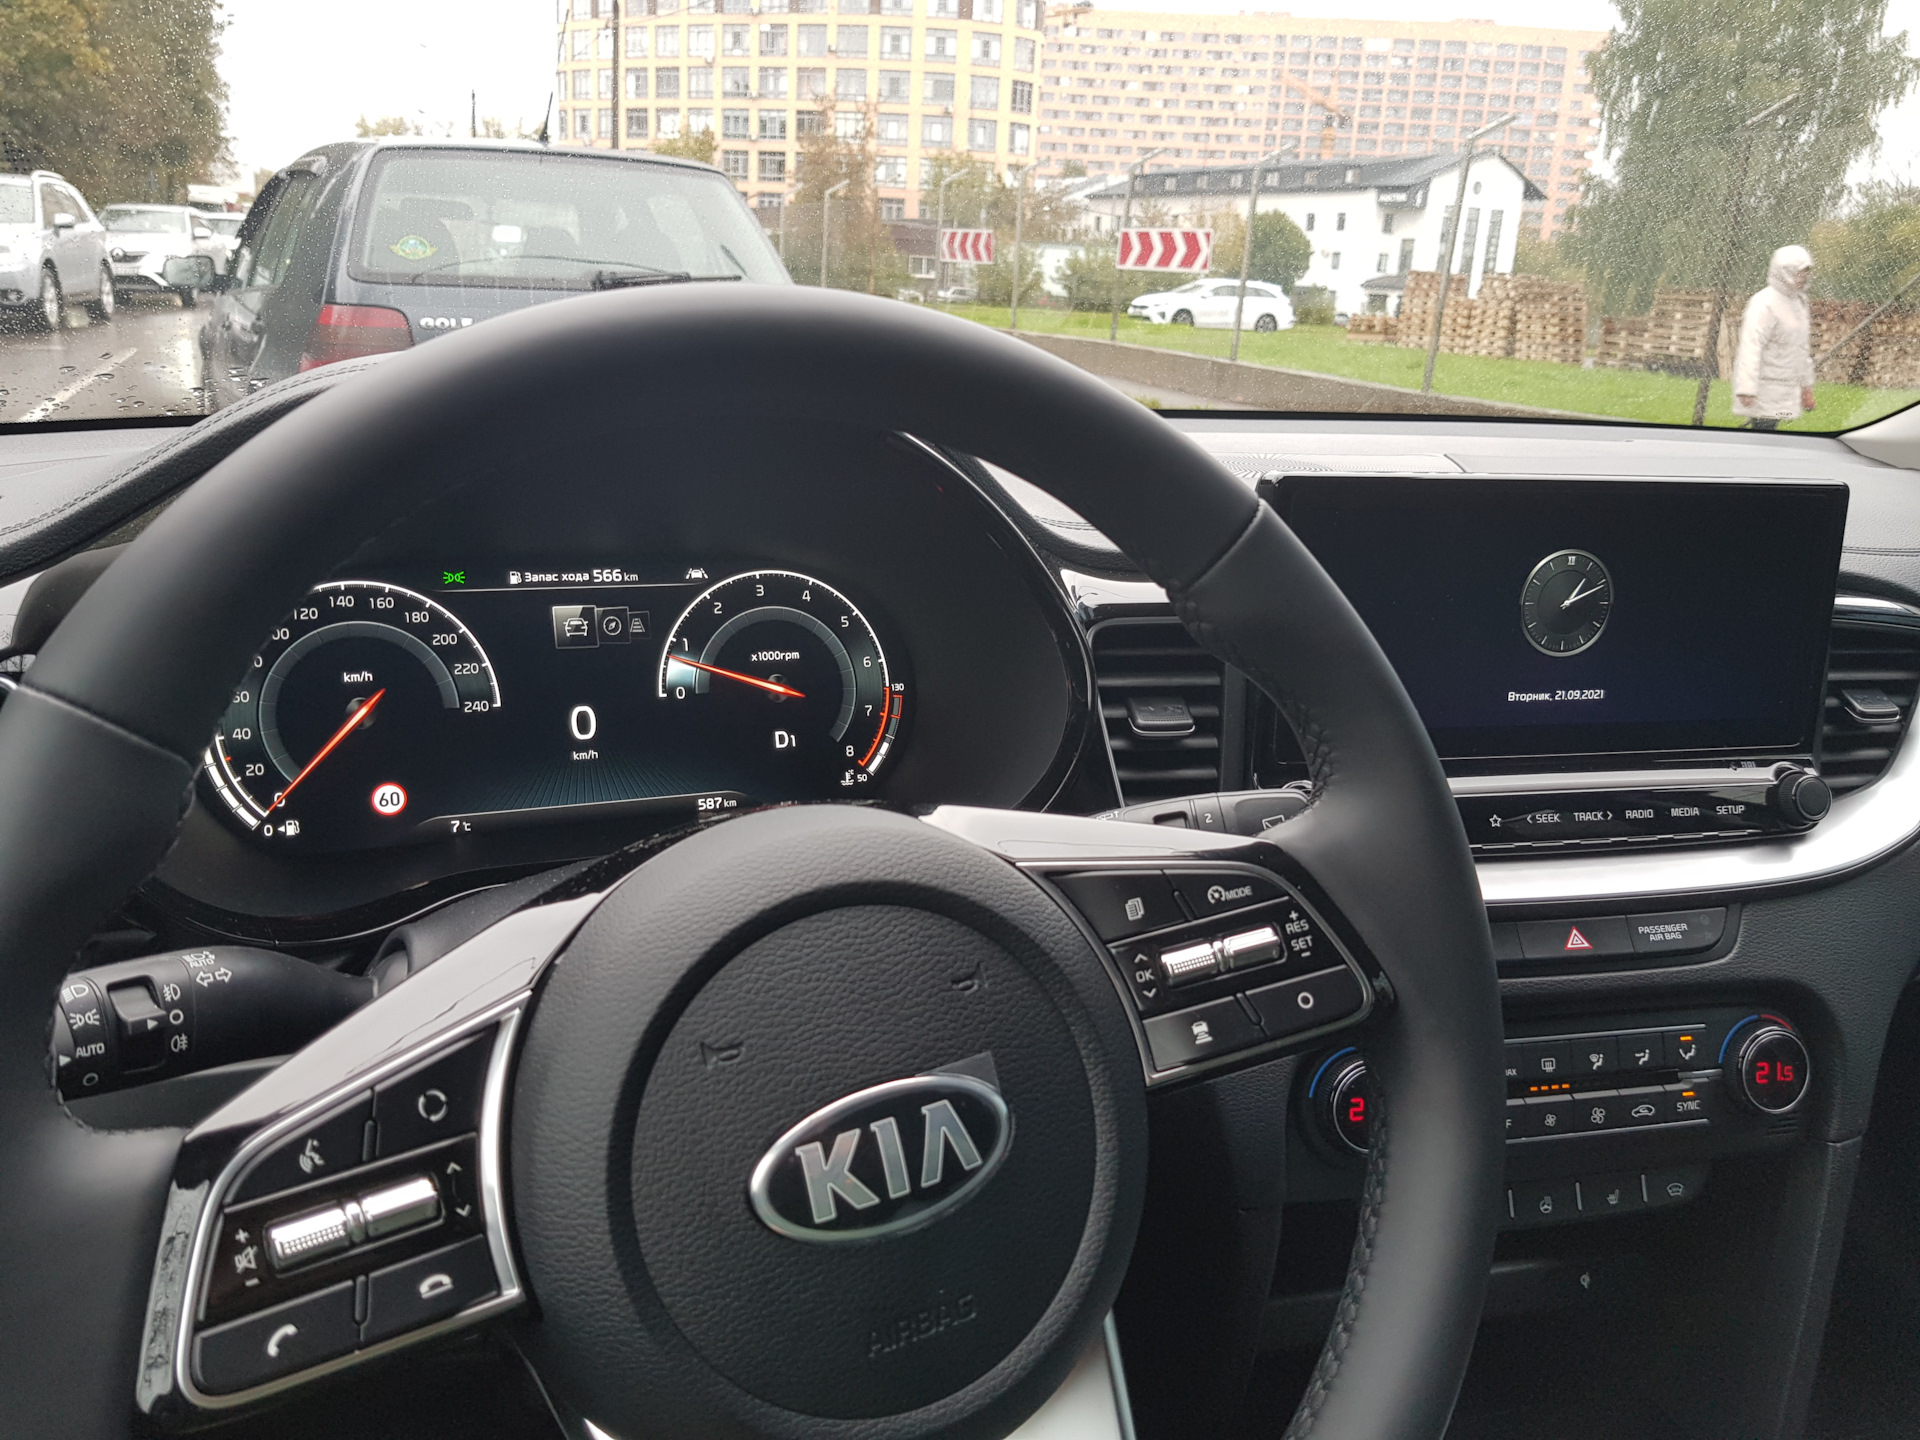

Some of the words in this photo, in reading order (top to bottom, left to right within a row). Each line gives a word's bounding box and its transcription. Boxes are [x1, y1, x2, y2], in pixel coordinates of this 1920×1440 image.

[524, 572, 559, 583] Запас
[561, 572, 590, 583] хода
[592, 568, 623, 583] 566
[623, 572, 639, 582] km
[755, 584, 765, 597] 3
[802, 590, 811, 602] 4
[329, 595, 355, 608] 140
[369, 596, 395, 609] 160
[713, 601, 723, 614] 2
[293, 607, 319, 620] 120
[404, 611, 430, 623] 180
[840, 615, 850, 628] 5
[431, 633, 459, 646] 200
[682, 637, 689, 652] 1
[751, 650, 800, 662] x1000rpm
[863, 655, 872, 668] 6
[454, 662, 479, 675] 220
[343, 670, 373, 683] km/h
[675, 686, 686, 700] 0
[890, 682, 905, 692] 130
[1507, 691, 1553, 703] Вторник,
[1554, 689, 1604, 701] 21.09.2021
[464, 700, 490, 713] 240
[864, 704, 873, 717] 7
[570, 705, 597, 741] 0
[232, 727, 252, 740] 40
[572, 749, 599, 761] km/h
[845, 745, 855, 757] 8
[245, 763, 265, 777] 20
[856, 773, 868, 783] 50
[378, 791, 401, 808] 60
[697, 796, 723, 811] 587
[723, 798, 737, 808] km
[1625, 808, 1654, 819] RADIO
[1670, 806, 1700, 817] MEDIA
[1715, 804, 1745, 815] SETUP
[1203, 812, 1213, 824] 2
[1535, 813, 1561, 824] SEEK
[1573, 811, 1604, 822] TRACK
[263, 824, 274, 837] 0
[450, 819, 460, 833] 7
[1224, 885, 1253, 901] MODE
[1285, 918, 1310, 935] RES
[1637, 922, 1689, 935] PASSENGER
[1648, 931, 1665, 942] AIR
[1664, 930, 1683, 940] BAG
[1290, 935, 1313, 951] SET
[188, 958, 215, 969] AUTO
[1135, 968, 1155, 983] OK
[74, 1041, 106, 1058] AUTO
[1755, 1061, 1794, 1084] 21.5
[1676, 1100, 1701, 1112] SYNC
[794, 1098, 983, 1225] KIA
